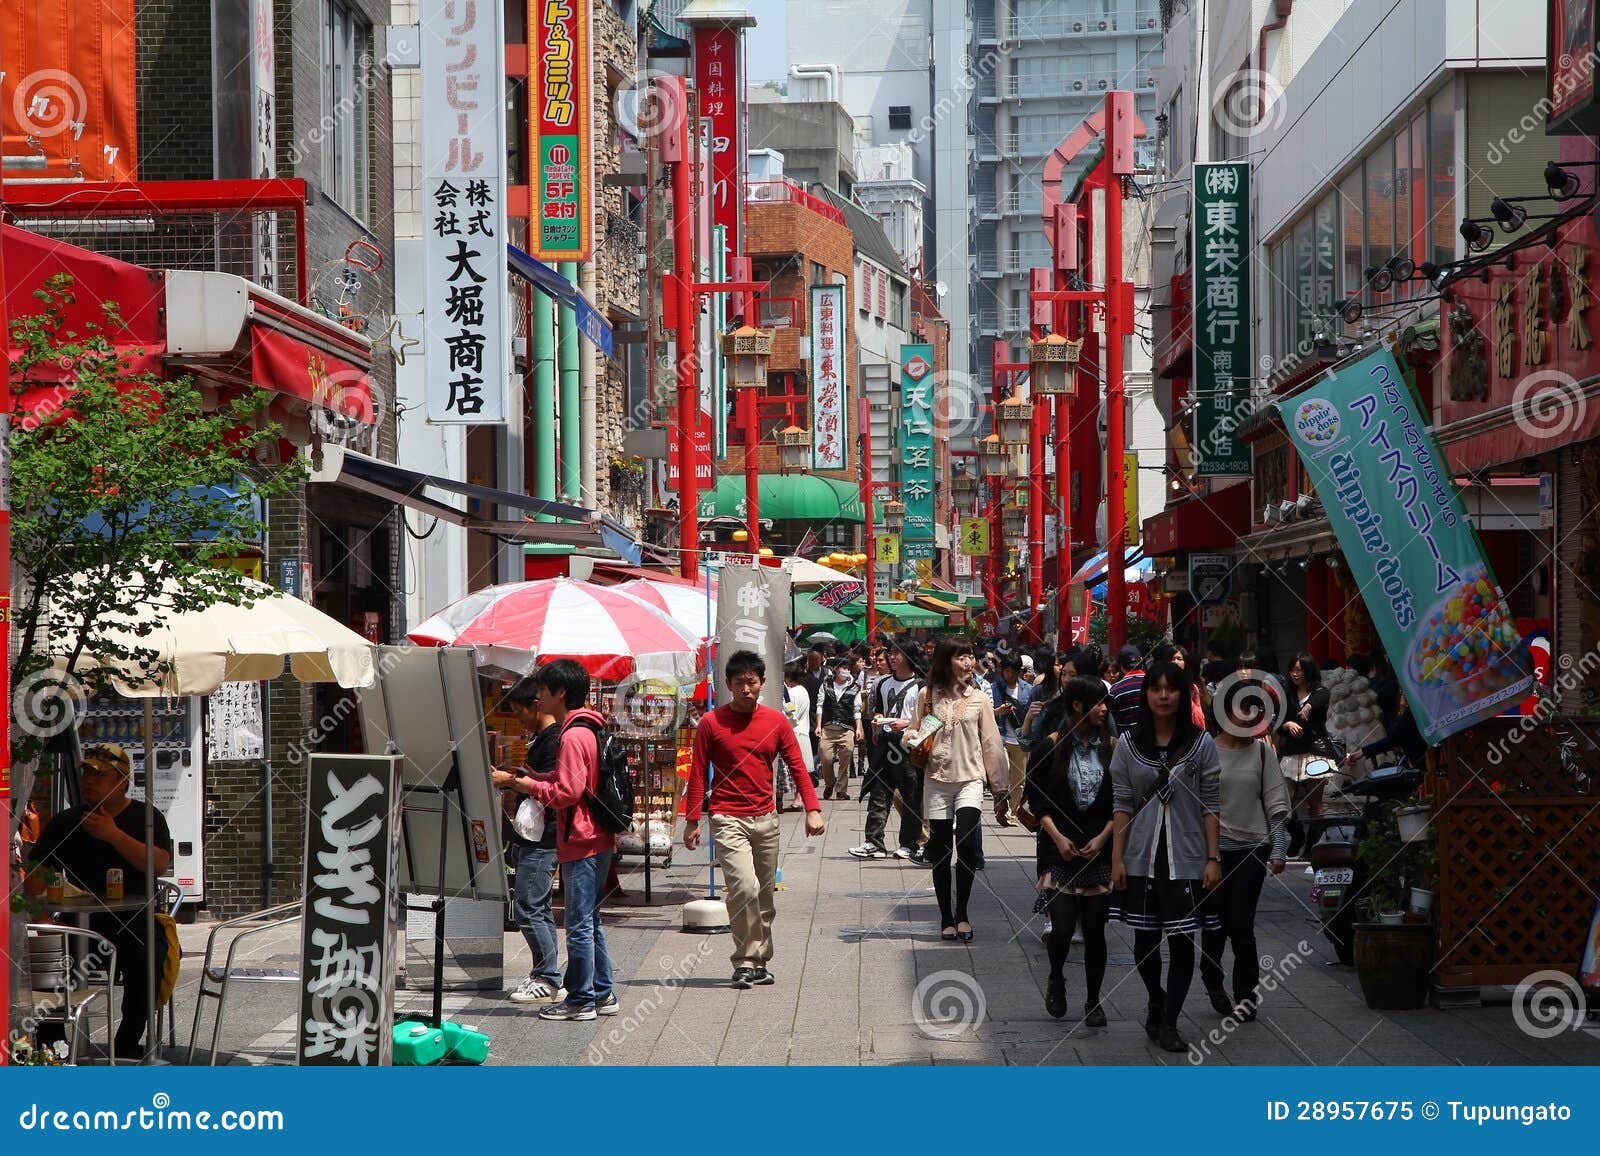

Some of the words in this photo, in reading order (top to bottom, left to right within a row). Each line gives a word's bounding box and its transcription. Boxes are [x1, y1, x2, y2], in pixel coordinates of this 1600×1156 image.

[708, 40, 723, 116] 中国料理
[544, 202, 576, 218] 受付
[545, 182, 574, 198] 5F
[445, 241, 486, 416] 大堀商店
[819, 294, 835, 350] 広東料理
[903, 388, 931, 500] 天仁茗茶
[1317, 415, 1339, 431] dots
[1350, 395, 1461, 592] アイスクリーム
[1323, 873, 1350, 883] 5582
